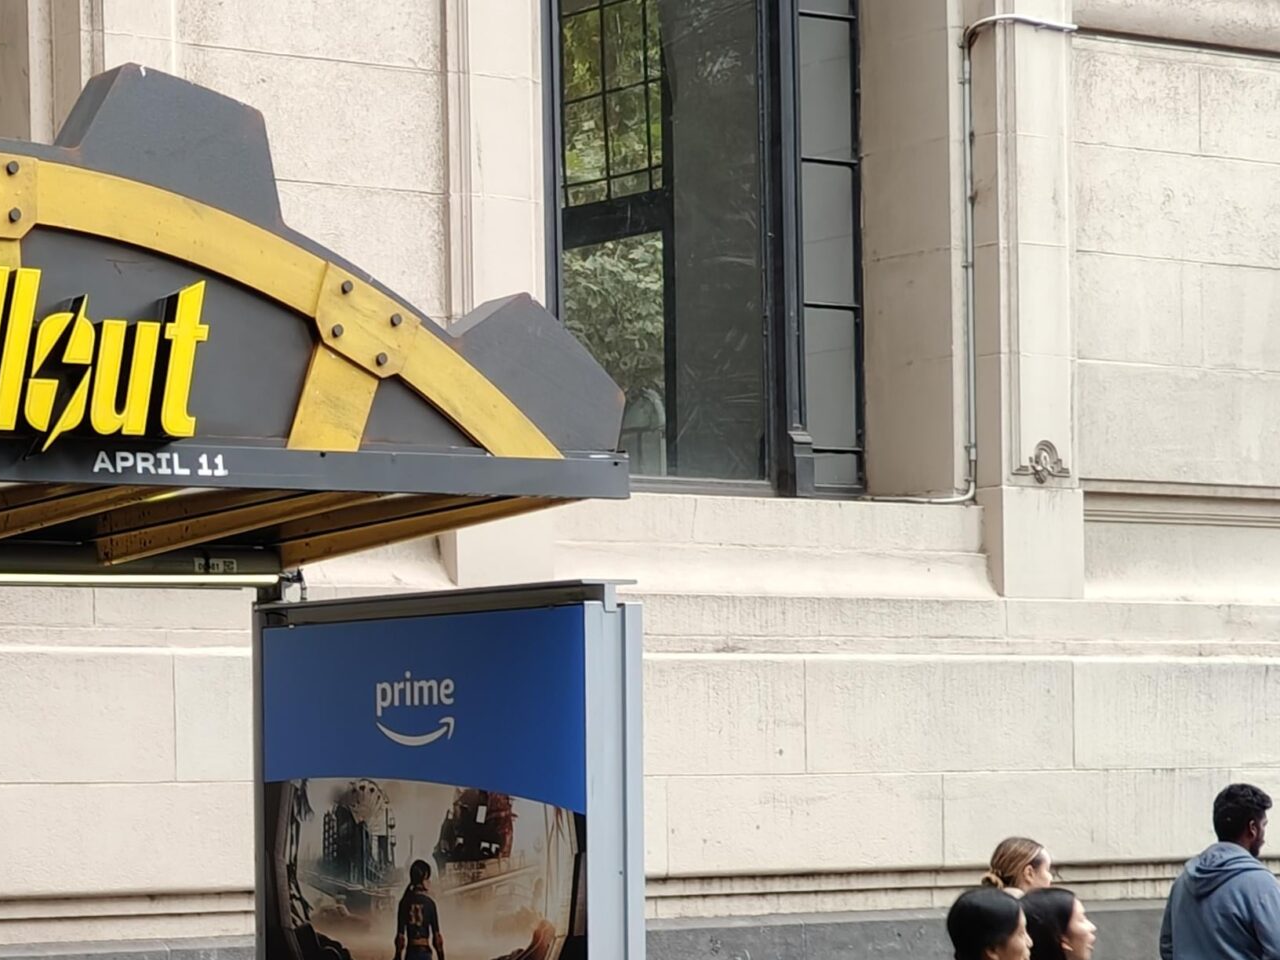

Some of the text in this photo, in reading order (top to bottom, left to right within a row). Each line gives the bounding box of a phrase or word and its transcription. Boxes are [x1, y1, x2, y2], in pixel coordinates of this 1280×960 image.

[92, 451, 230, 477] APRIL 11
[375, 670, 456, 717] prime
